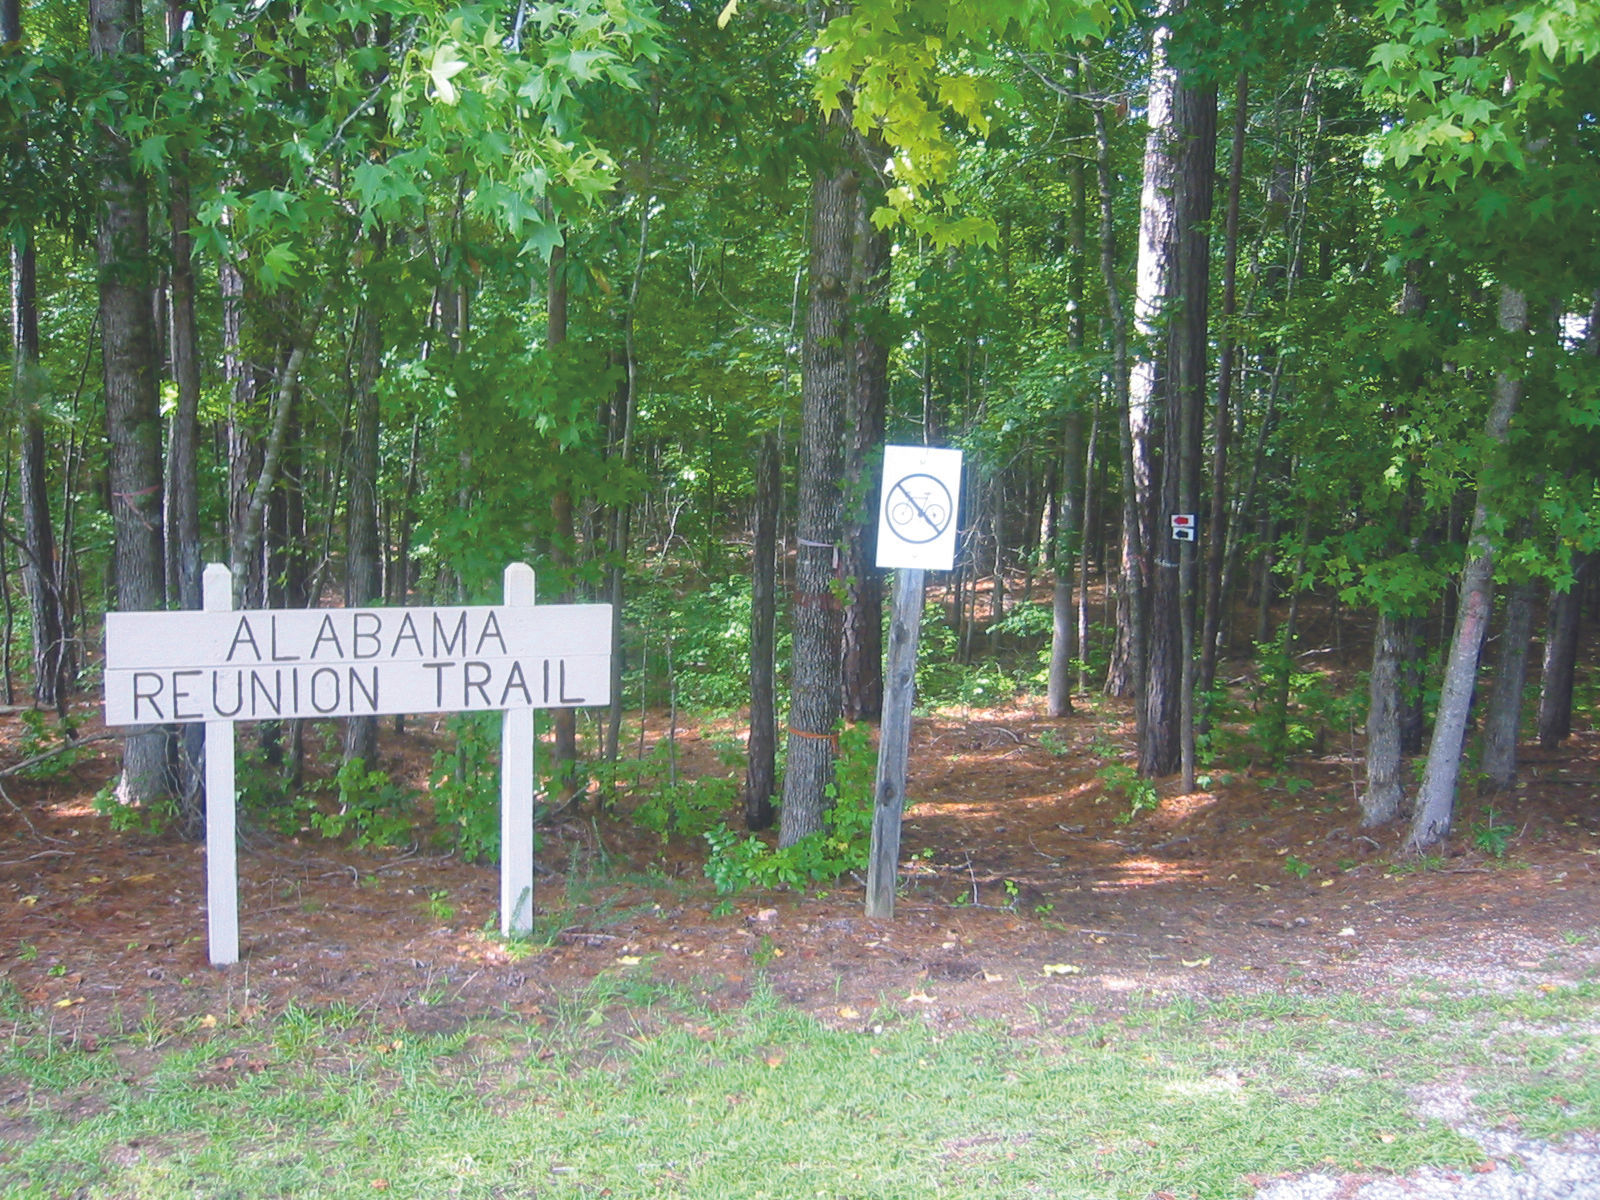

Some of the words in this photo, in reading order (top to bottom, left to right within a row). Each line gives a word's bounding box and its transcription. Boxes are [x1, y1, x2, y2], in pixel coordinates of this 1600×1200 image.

[226, 609, 508, 662] ALABAMA
[133, 665, 380, 720] REUNION
[422, 658, 586, 708] TRAIL
